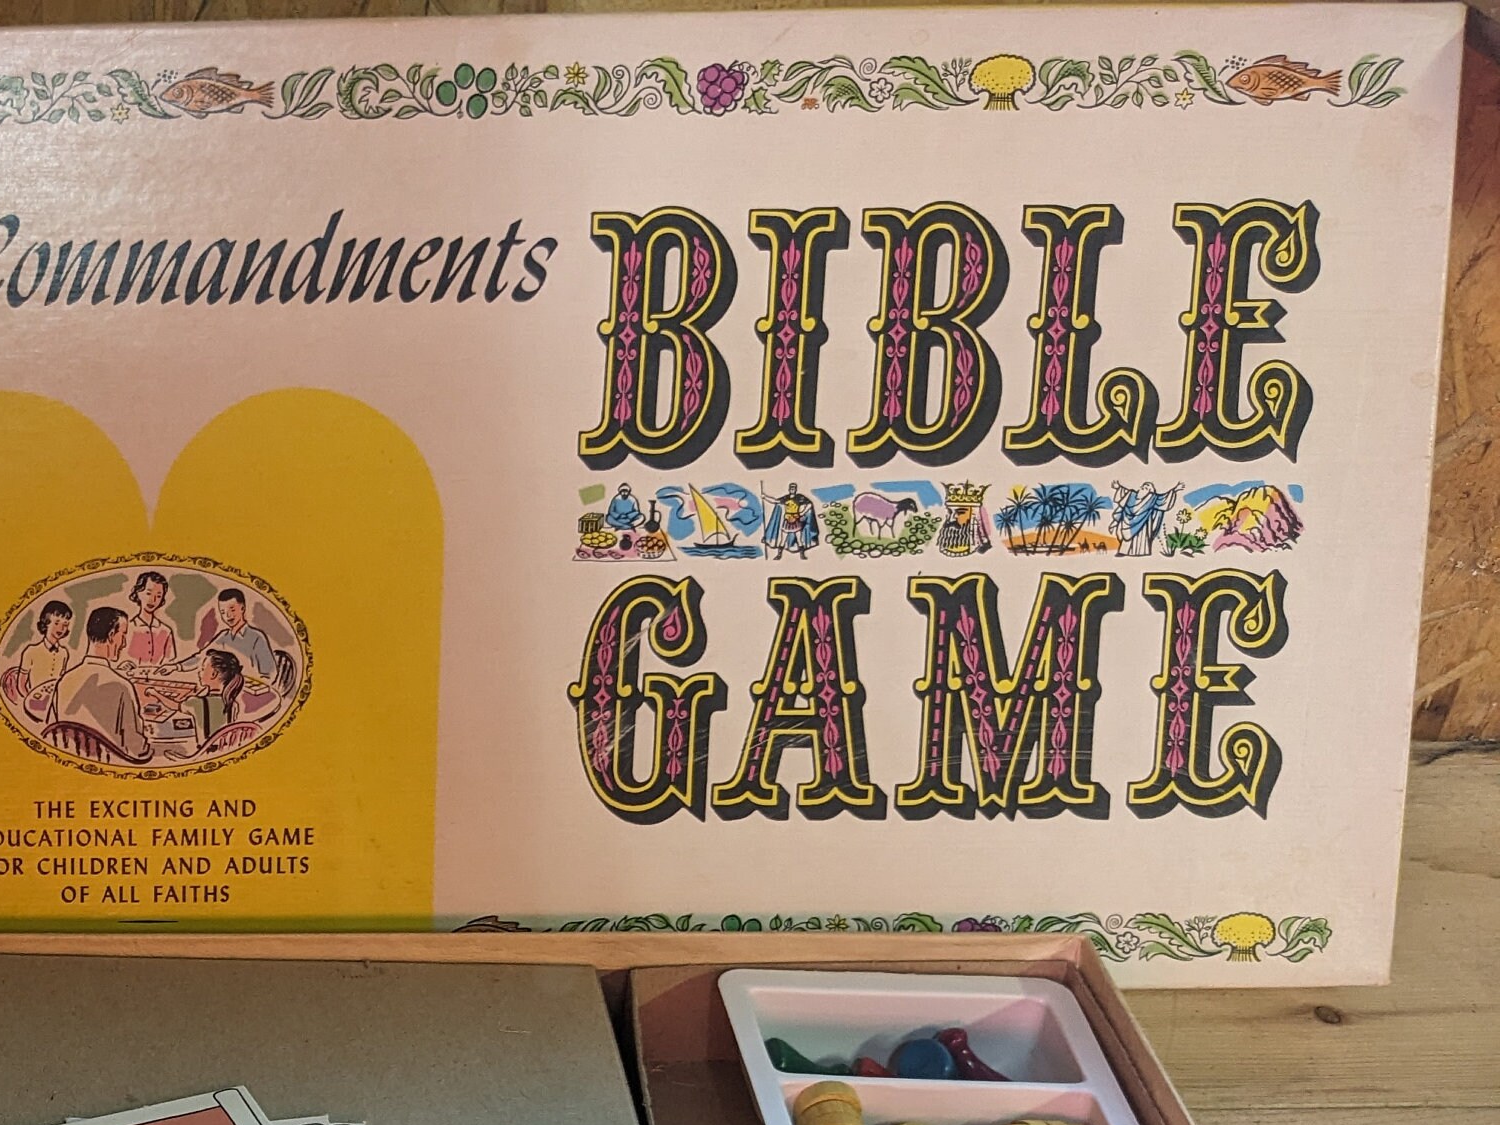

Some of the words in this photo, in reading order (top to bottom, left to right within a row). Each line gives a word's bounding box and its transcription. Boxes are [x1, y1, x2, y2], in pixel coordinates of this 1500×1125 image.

[577, 198, 1321, 470] BIBLE
[568, 568, 1289, 823] GAME
[34, 800, 75, 819] THE
[90, 800, 194, 818] EXCITING
[207, 799, 257, 818] AND
[151, 828, 235, 847] FAMILY
[247, 827, 315, 846] GAME
[36, 857, 149, 876] CHILDREN
[161, 856, 211, 875] AND
[224, 856, 310, 874] ADULTS
[61, 886, 90, 904] OF
[102, 885, 139, 903] ALL
[153, 884, 230, 903] FAITHS
